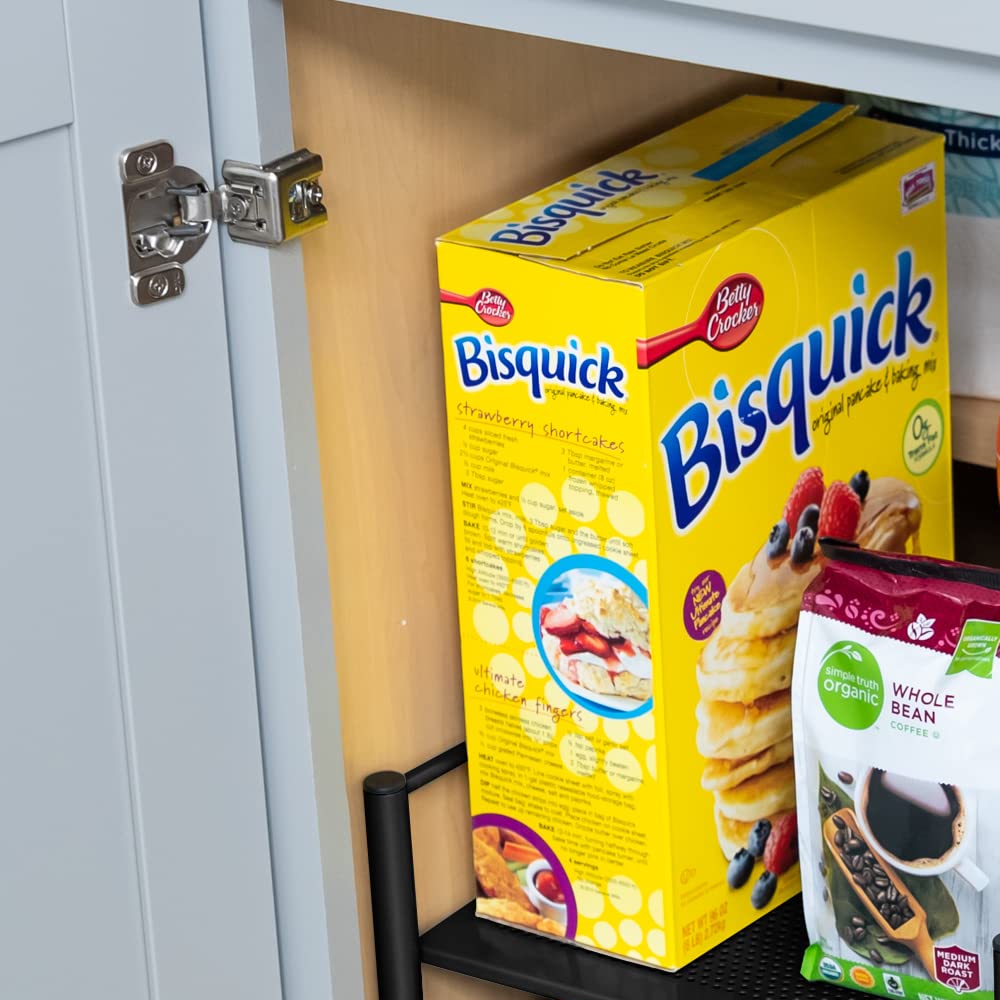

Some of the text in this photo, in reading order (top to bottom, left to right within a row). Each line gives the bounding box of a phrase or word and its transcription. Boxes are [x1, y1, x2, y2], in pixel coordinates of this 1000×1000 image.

[489, 169, 659, 246] Bisquick
[475, 300, 511, 320] Crocker
[481, 291, 507, 311] Betty
[717, 283, 752, 314] Betty
[706, 302, 759, 342] Crocker
[454, 334, 625, 399] Bisquick
[660, 250, 933, 530] Bisquick
[811, 394, 844, 435] original
[847, 378, 882, 409] pancake
[456, 401, 625, 454] strawberry shortcakes
[474, 665, 524, 689] ultimate
[825, 666, 879, 691] simple truth
[475, 682, 584, 723] chicken fingers
[824, 679, 879, 706] organic
[893, 682, 955, 709] WHOLE
[892, 701, 936, 724] BEAN
[890, 721, 929, 738] COFFEE
[937, 950, 976, 963] MEDIUM
[943, 960, 970, 971] DARK
[941, 966, 974, 978] ROAST
